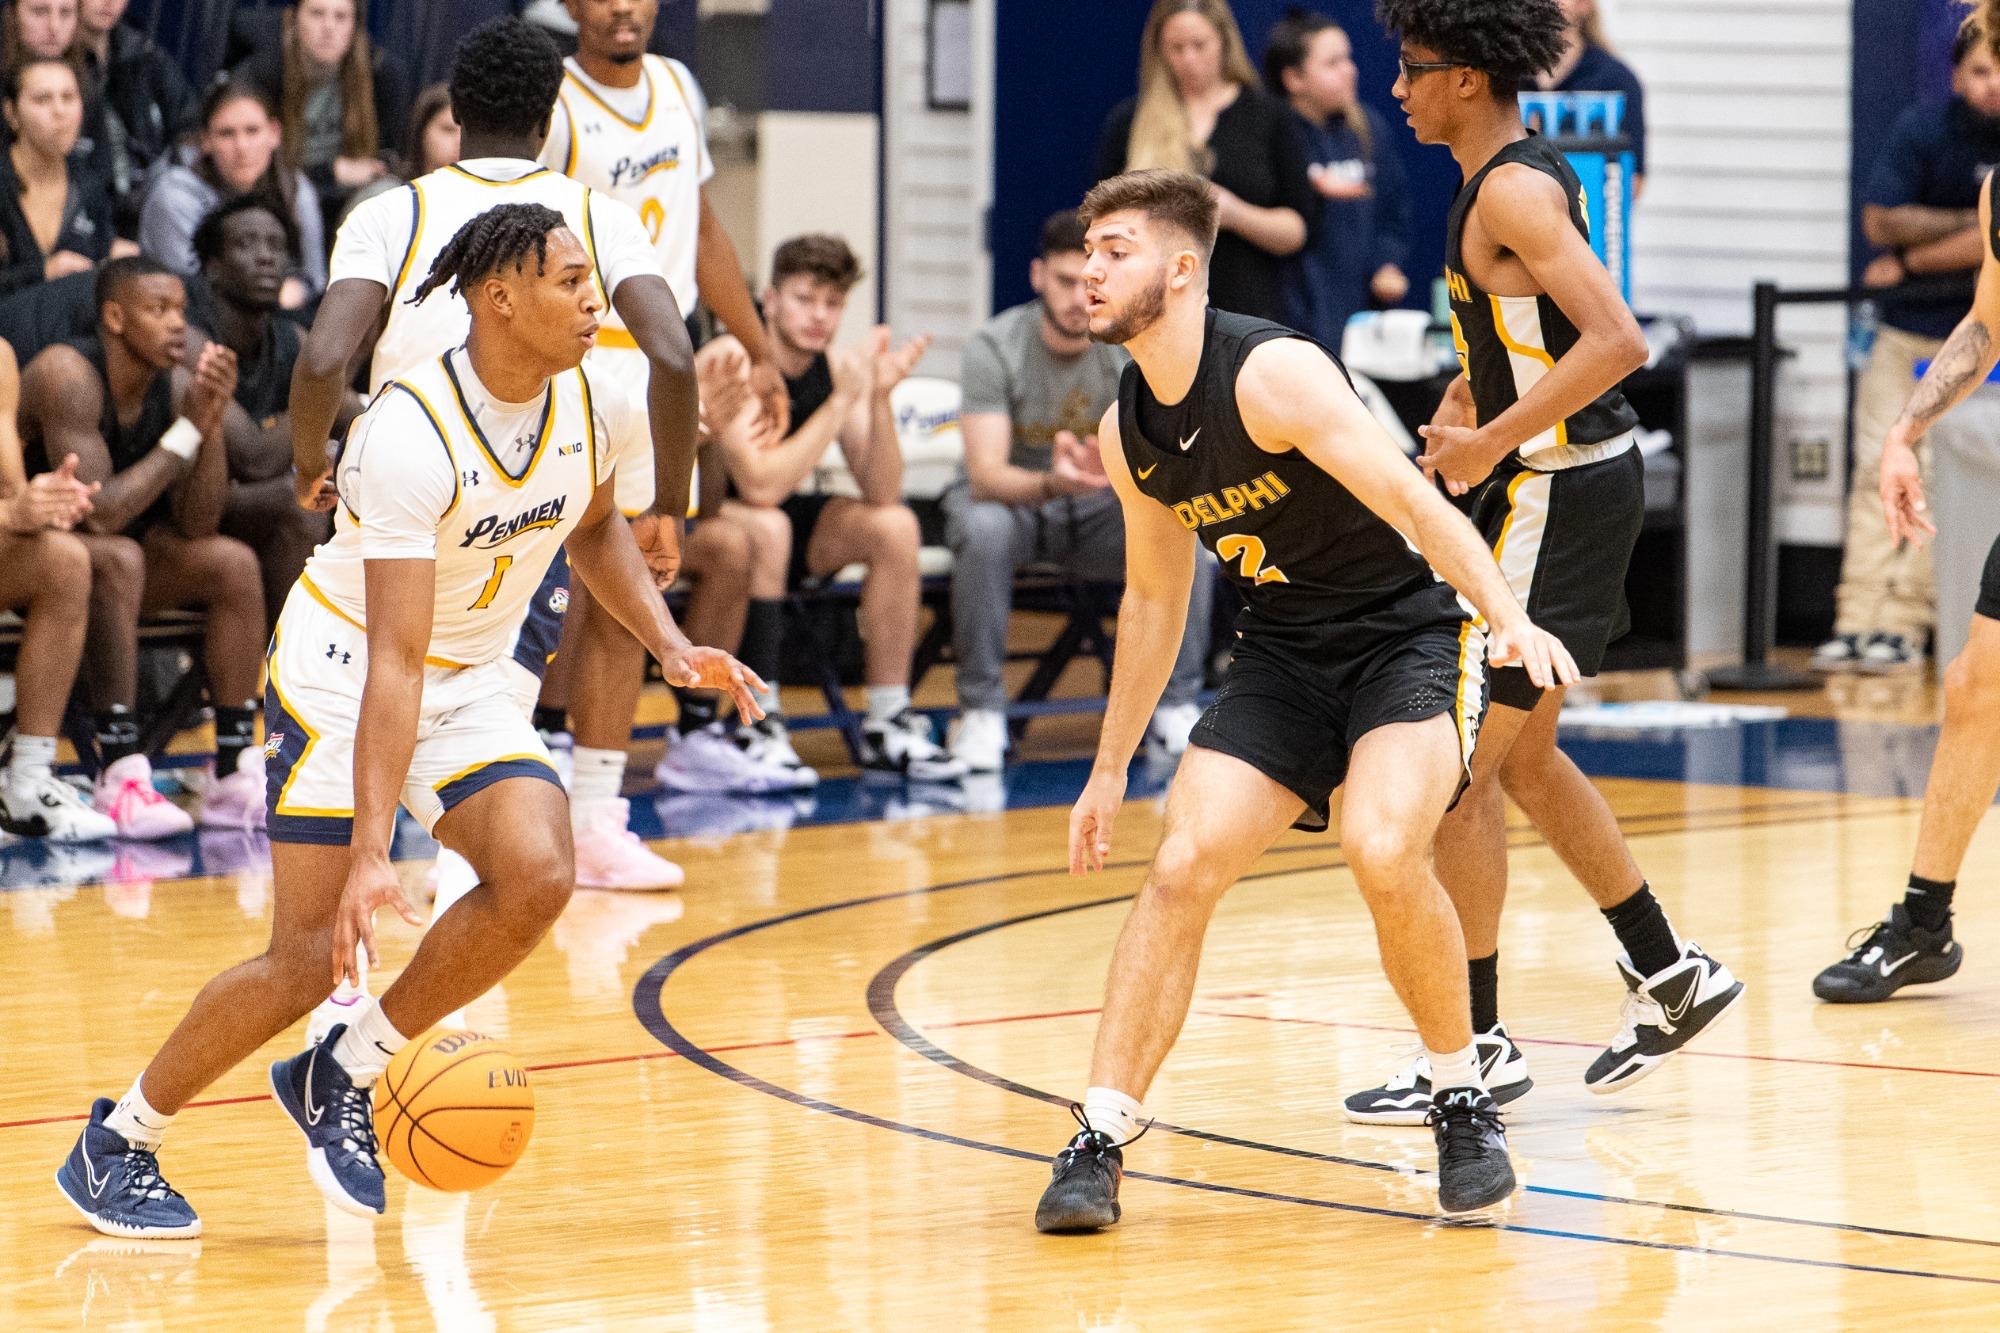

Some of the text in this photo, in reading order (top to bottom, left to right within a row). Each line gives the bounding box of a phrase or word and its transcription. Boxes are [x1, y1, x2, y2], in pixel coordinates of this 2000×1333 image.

[459, 494, 567, 547] PENMEN
[1170, 470, 1291, 531] DELPHI
[467, 555, 514, 611] 1
[1216, 533, 1290, 586] 2
